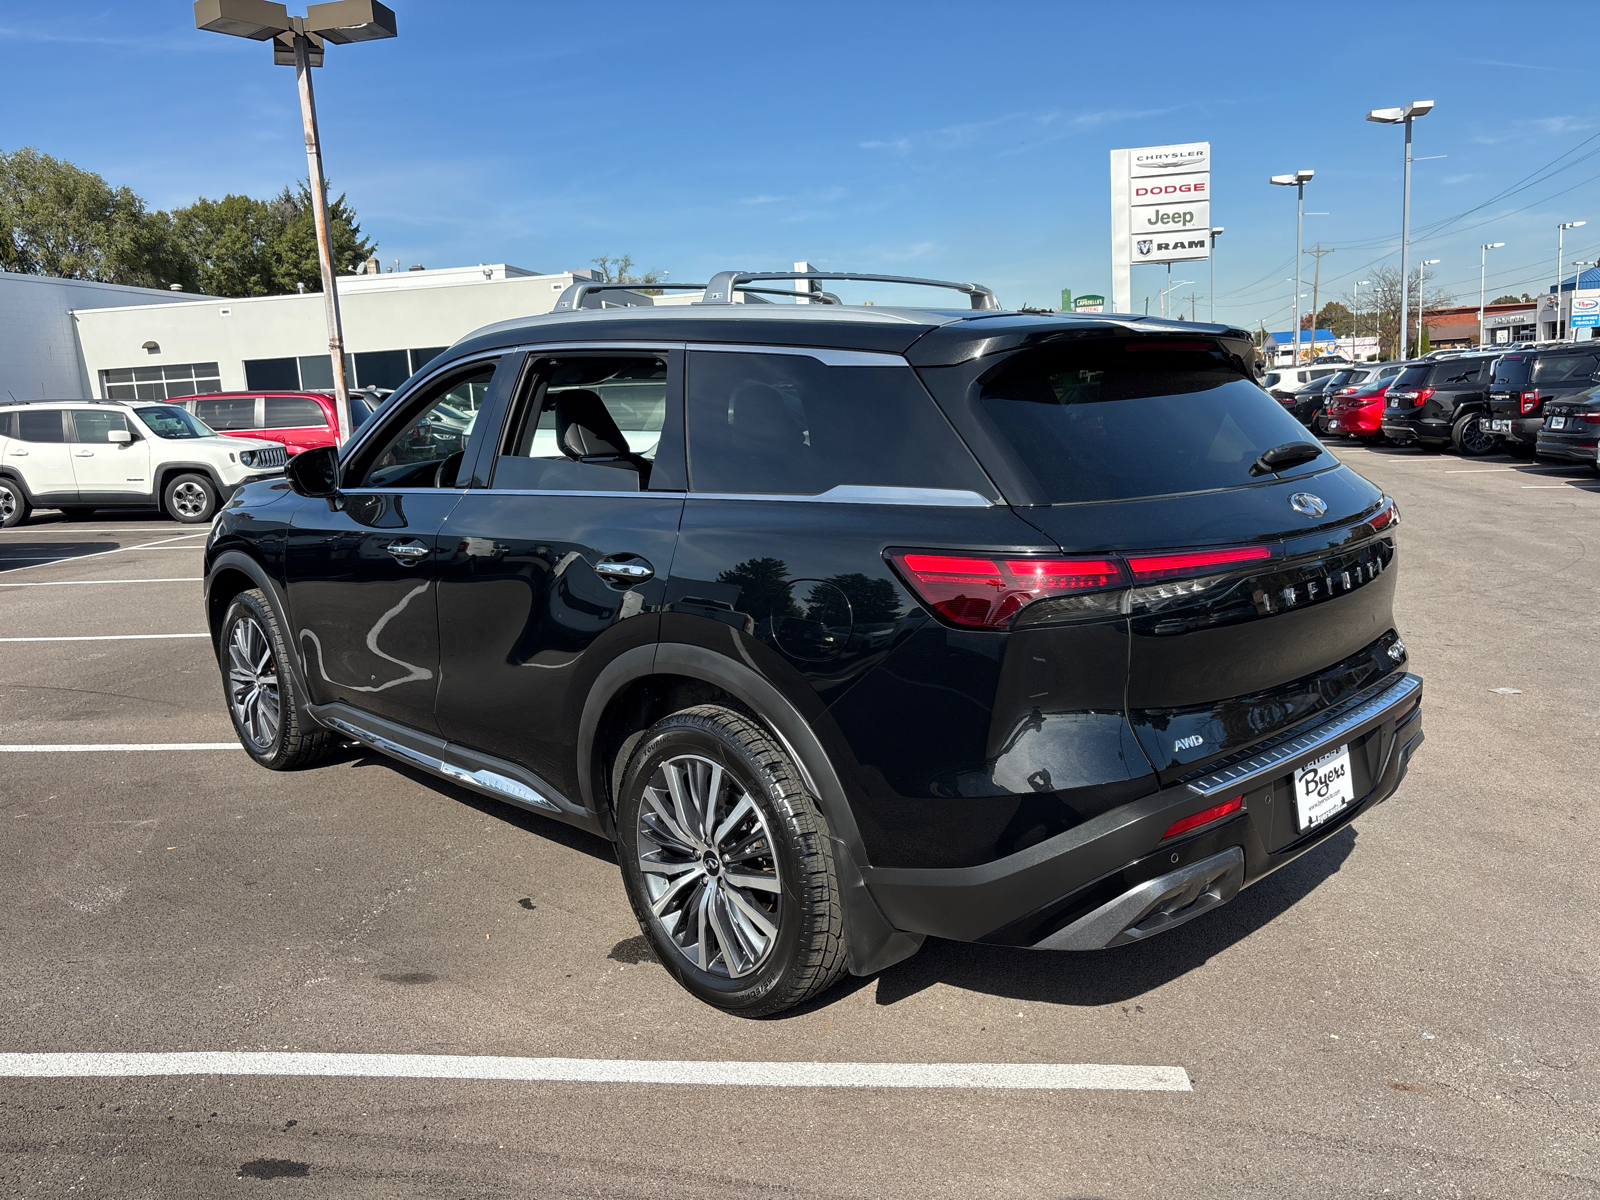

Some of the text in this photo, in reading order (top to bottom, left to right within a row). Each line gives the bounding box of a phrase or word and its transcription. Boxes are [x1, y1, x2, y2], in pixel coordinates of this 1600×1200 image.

[1136, 150, 1204, 162] CHRYSLER
[1136, 183, 1206, 196] DODGE
[1147, 209, 1194, 226] Jeep
[1156, 239, 1205, 251] RAM
[1174, 734, 1204, 752] AWD
[1298, 763, 1346, 798] Byers
